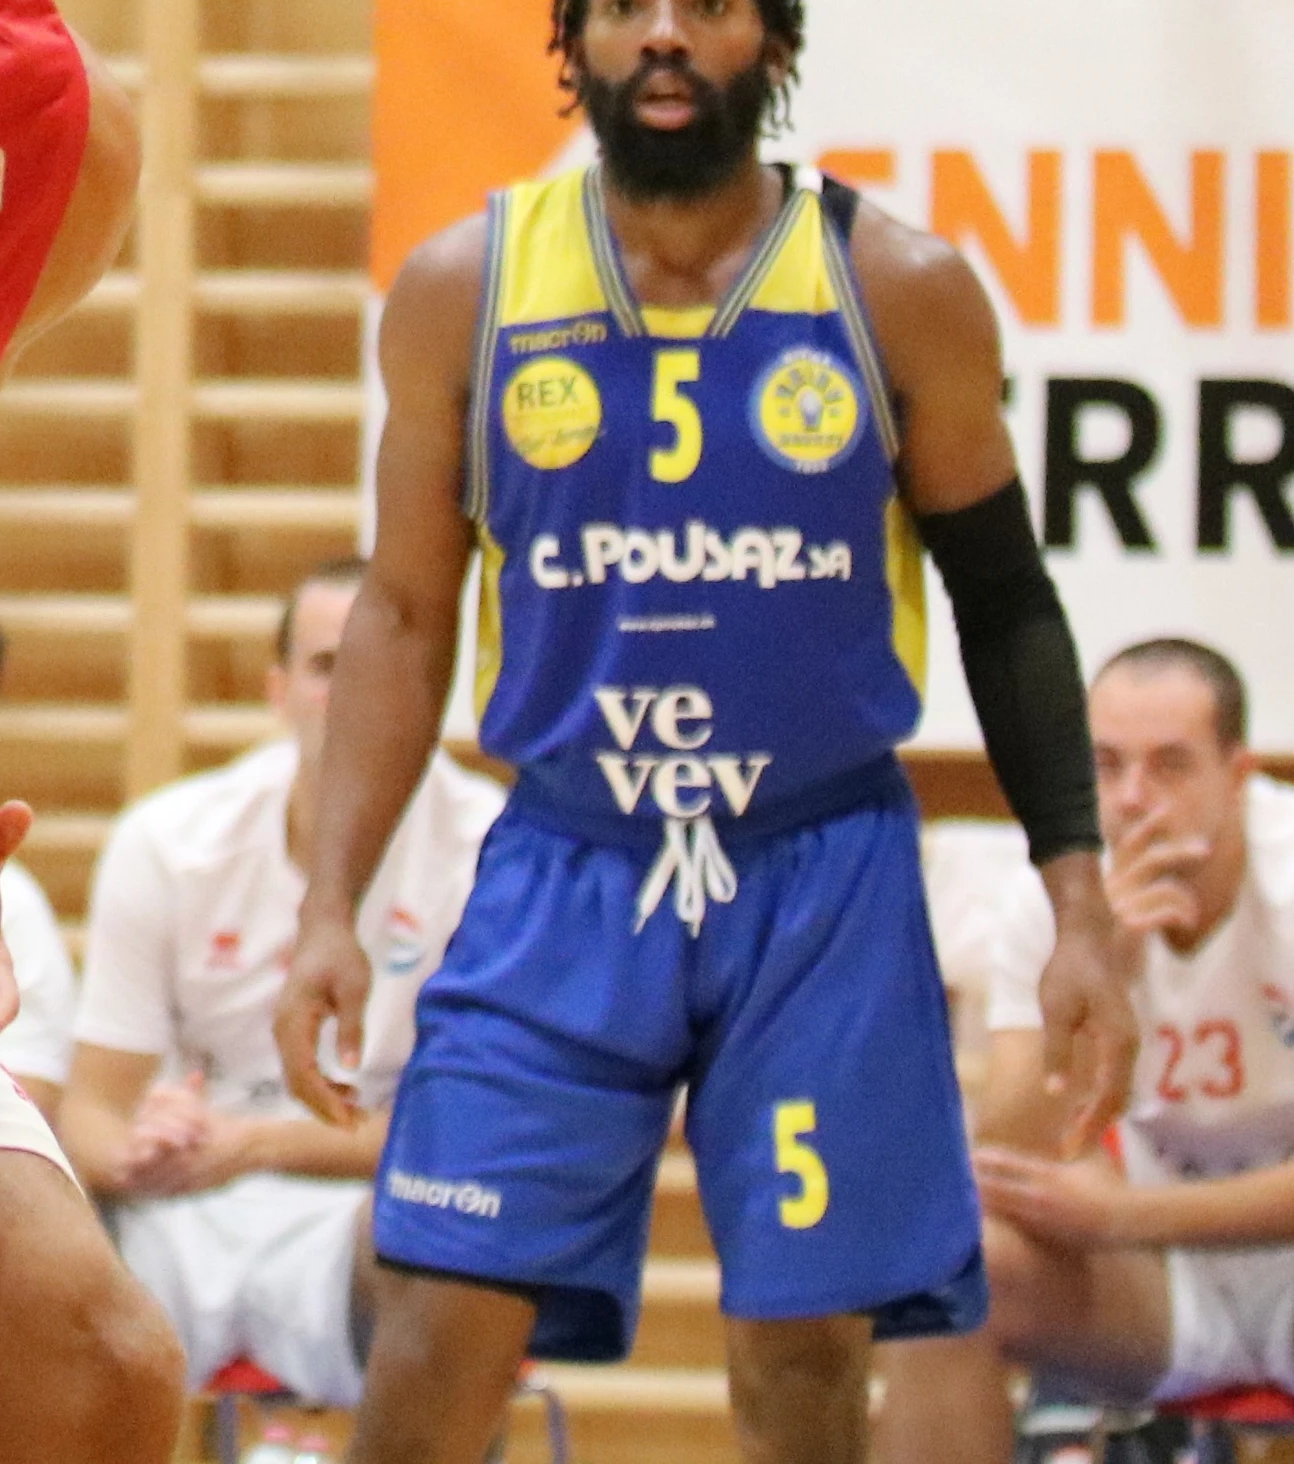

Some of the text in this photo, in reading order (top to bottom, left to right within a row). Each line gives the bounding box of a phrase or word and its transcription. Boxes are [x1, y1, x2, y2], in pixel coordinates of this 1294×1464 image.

[814, 149, 1292, 327] NNI
[516, 376, 580, 411] REX
[649, 347, 703, 484] 5
[1003, 377, 1294, 551] RR
[594, 685, 713, 750] ve
[596, 753, 774, 818] vev
[1156, 1019, 1246, 1102] 23
[388, 1168, 502, 1219] macron
[773, 1101, 831, 1230] 5
